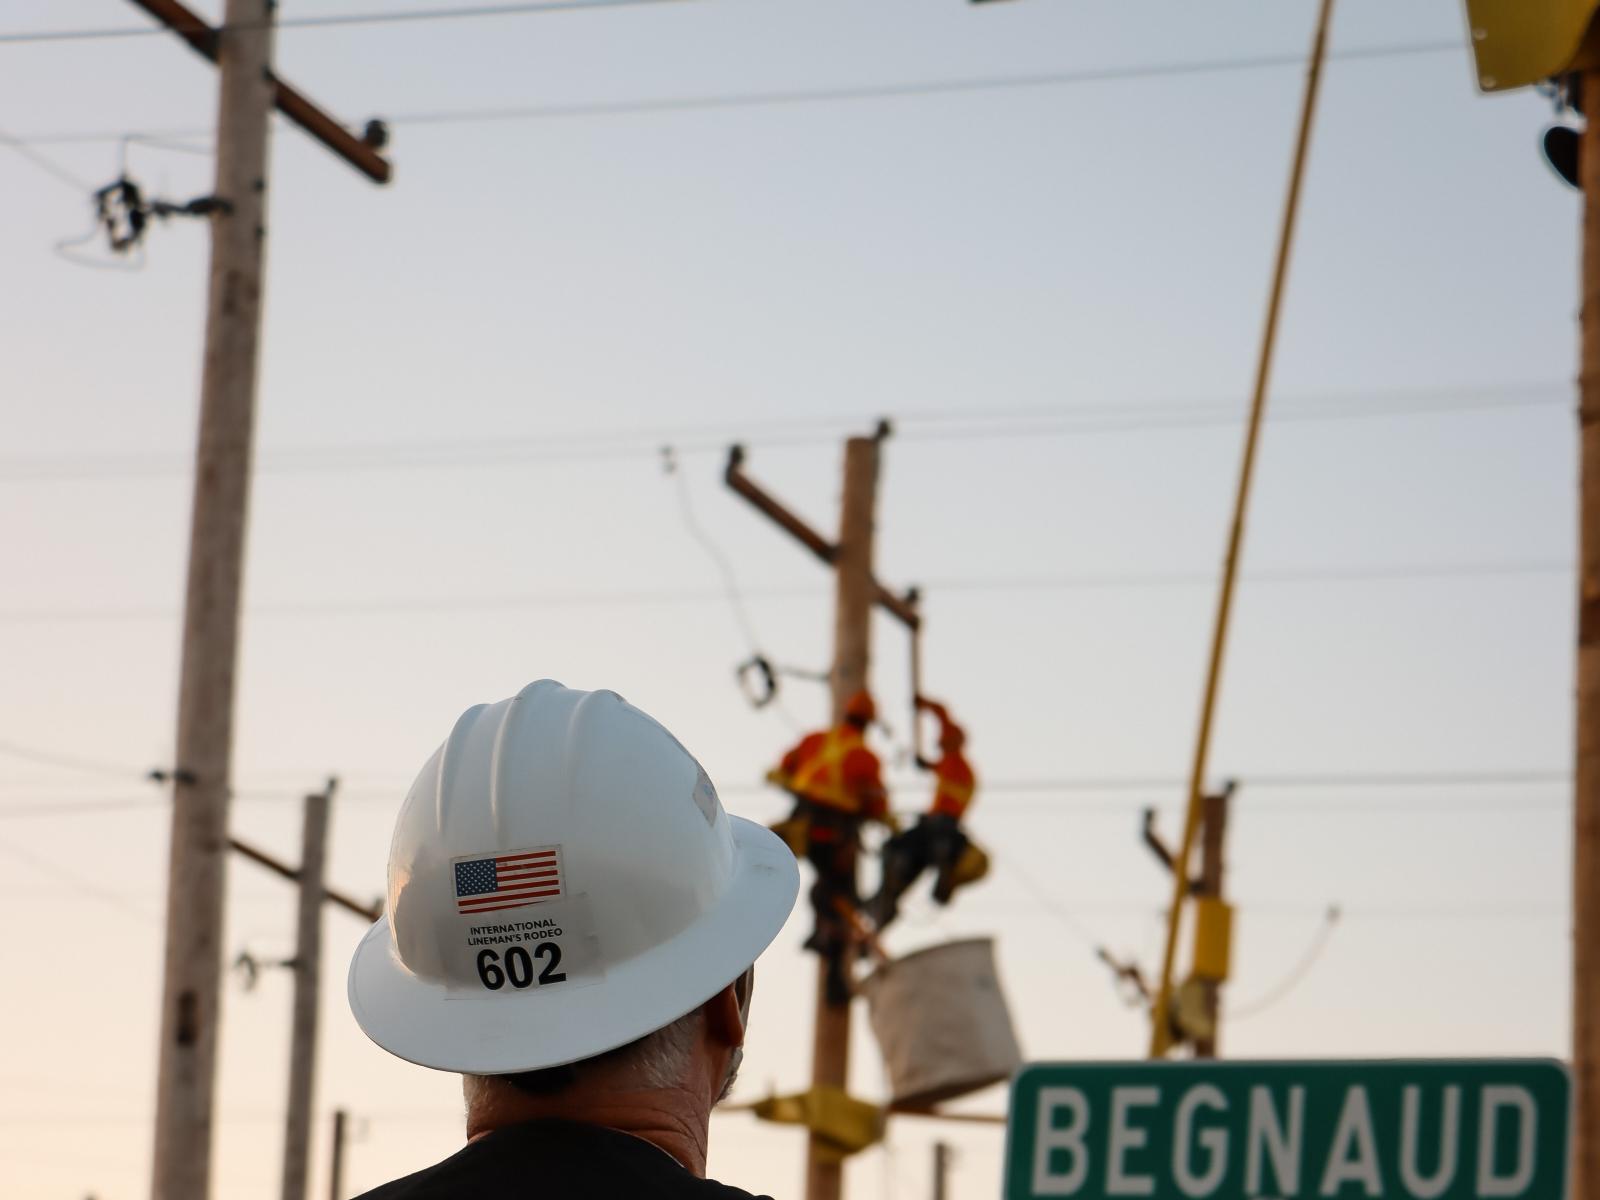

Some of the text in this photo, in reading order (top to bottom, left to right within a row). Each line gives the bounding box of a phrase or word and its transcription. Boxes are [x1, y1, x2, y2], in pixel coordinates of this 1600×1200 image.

[467, 927, 563, 946] LINEMAN'S RODEO
[470, 918, 557, 936] INTERNATIONAL
[476, 941, 567, 991] 602
[1030, 1082, 1538, 1200] BEGNAUD
